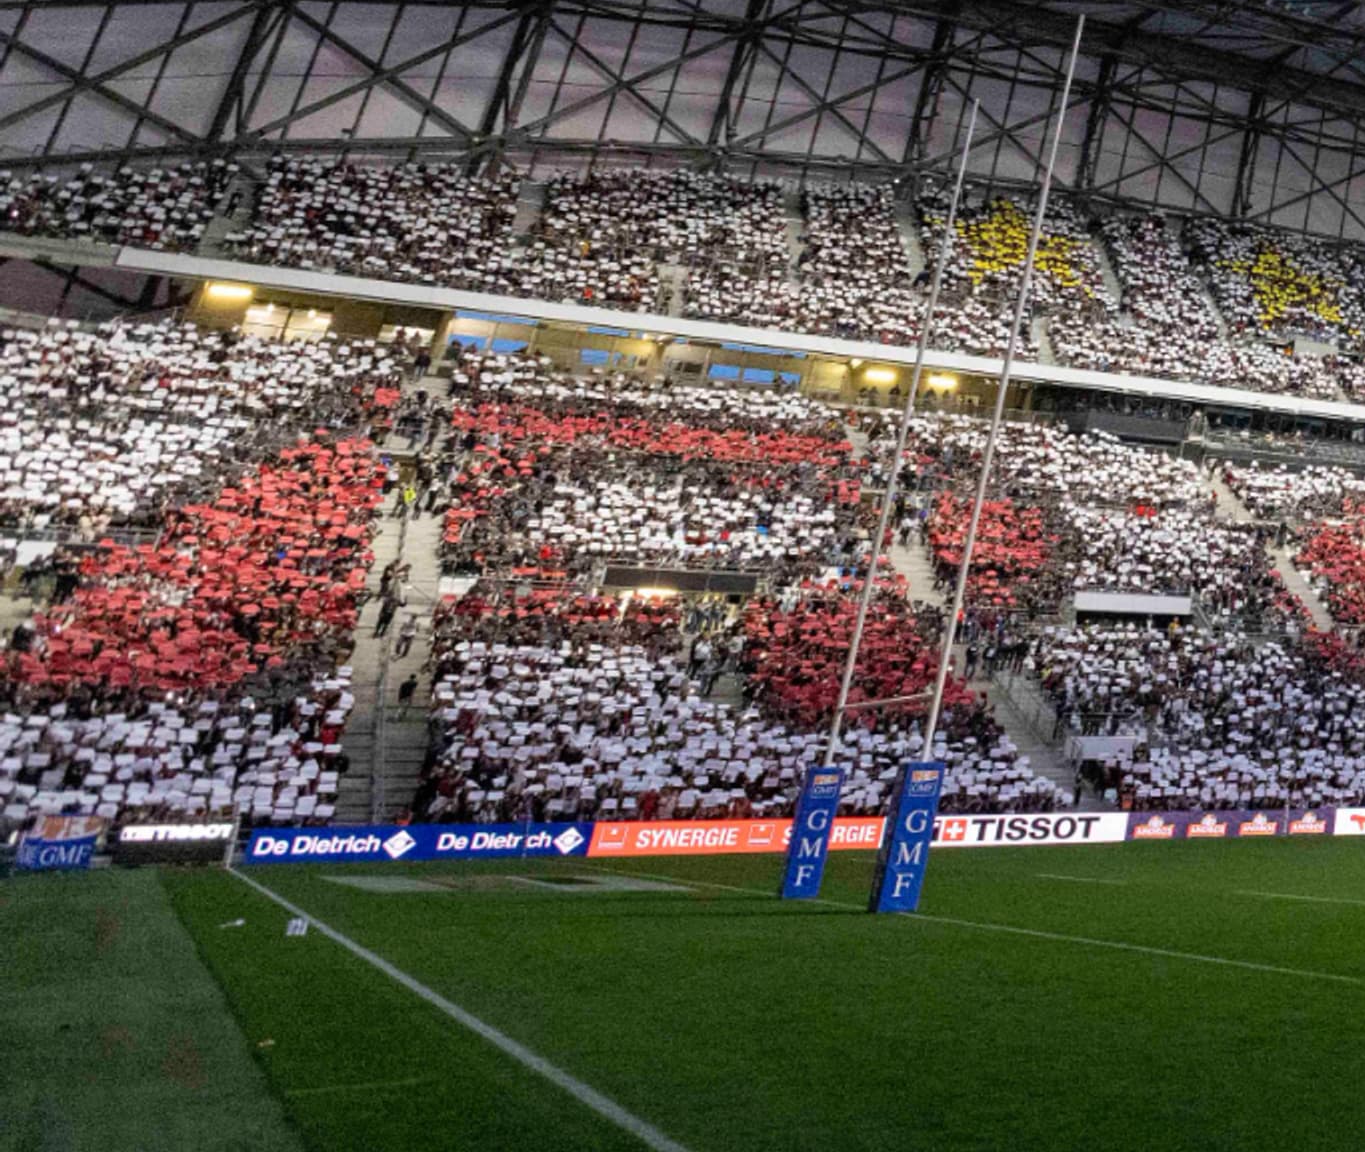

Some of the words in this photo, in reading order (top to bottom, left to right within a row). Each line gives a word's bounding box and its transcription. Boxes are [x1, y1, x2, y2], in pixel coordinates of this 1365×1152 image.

[635, 826, 738, 847] SYNERGIE
[781, 824, 877, 845] SRGIE
[972, 816, 1101, 841] TISSOT
[253, 836, 287, 855] De
[291, 834, 382, 854] Dietrich
[436, 833, 468, 851] De
[470, 830, 552, 850] Dietrch
[793, 809, 830, 887] GMF
[40, 845, 91, 865] GMF
[889, 809, 929, 897] GMF
